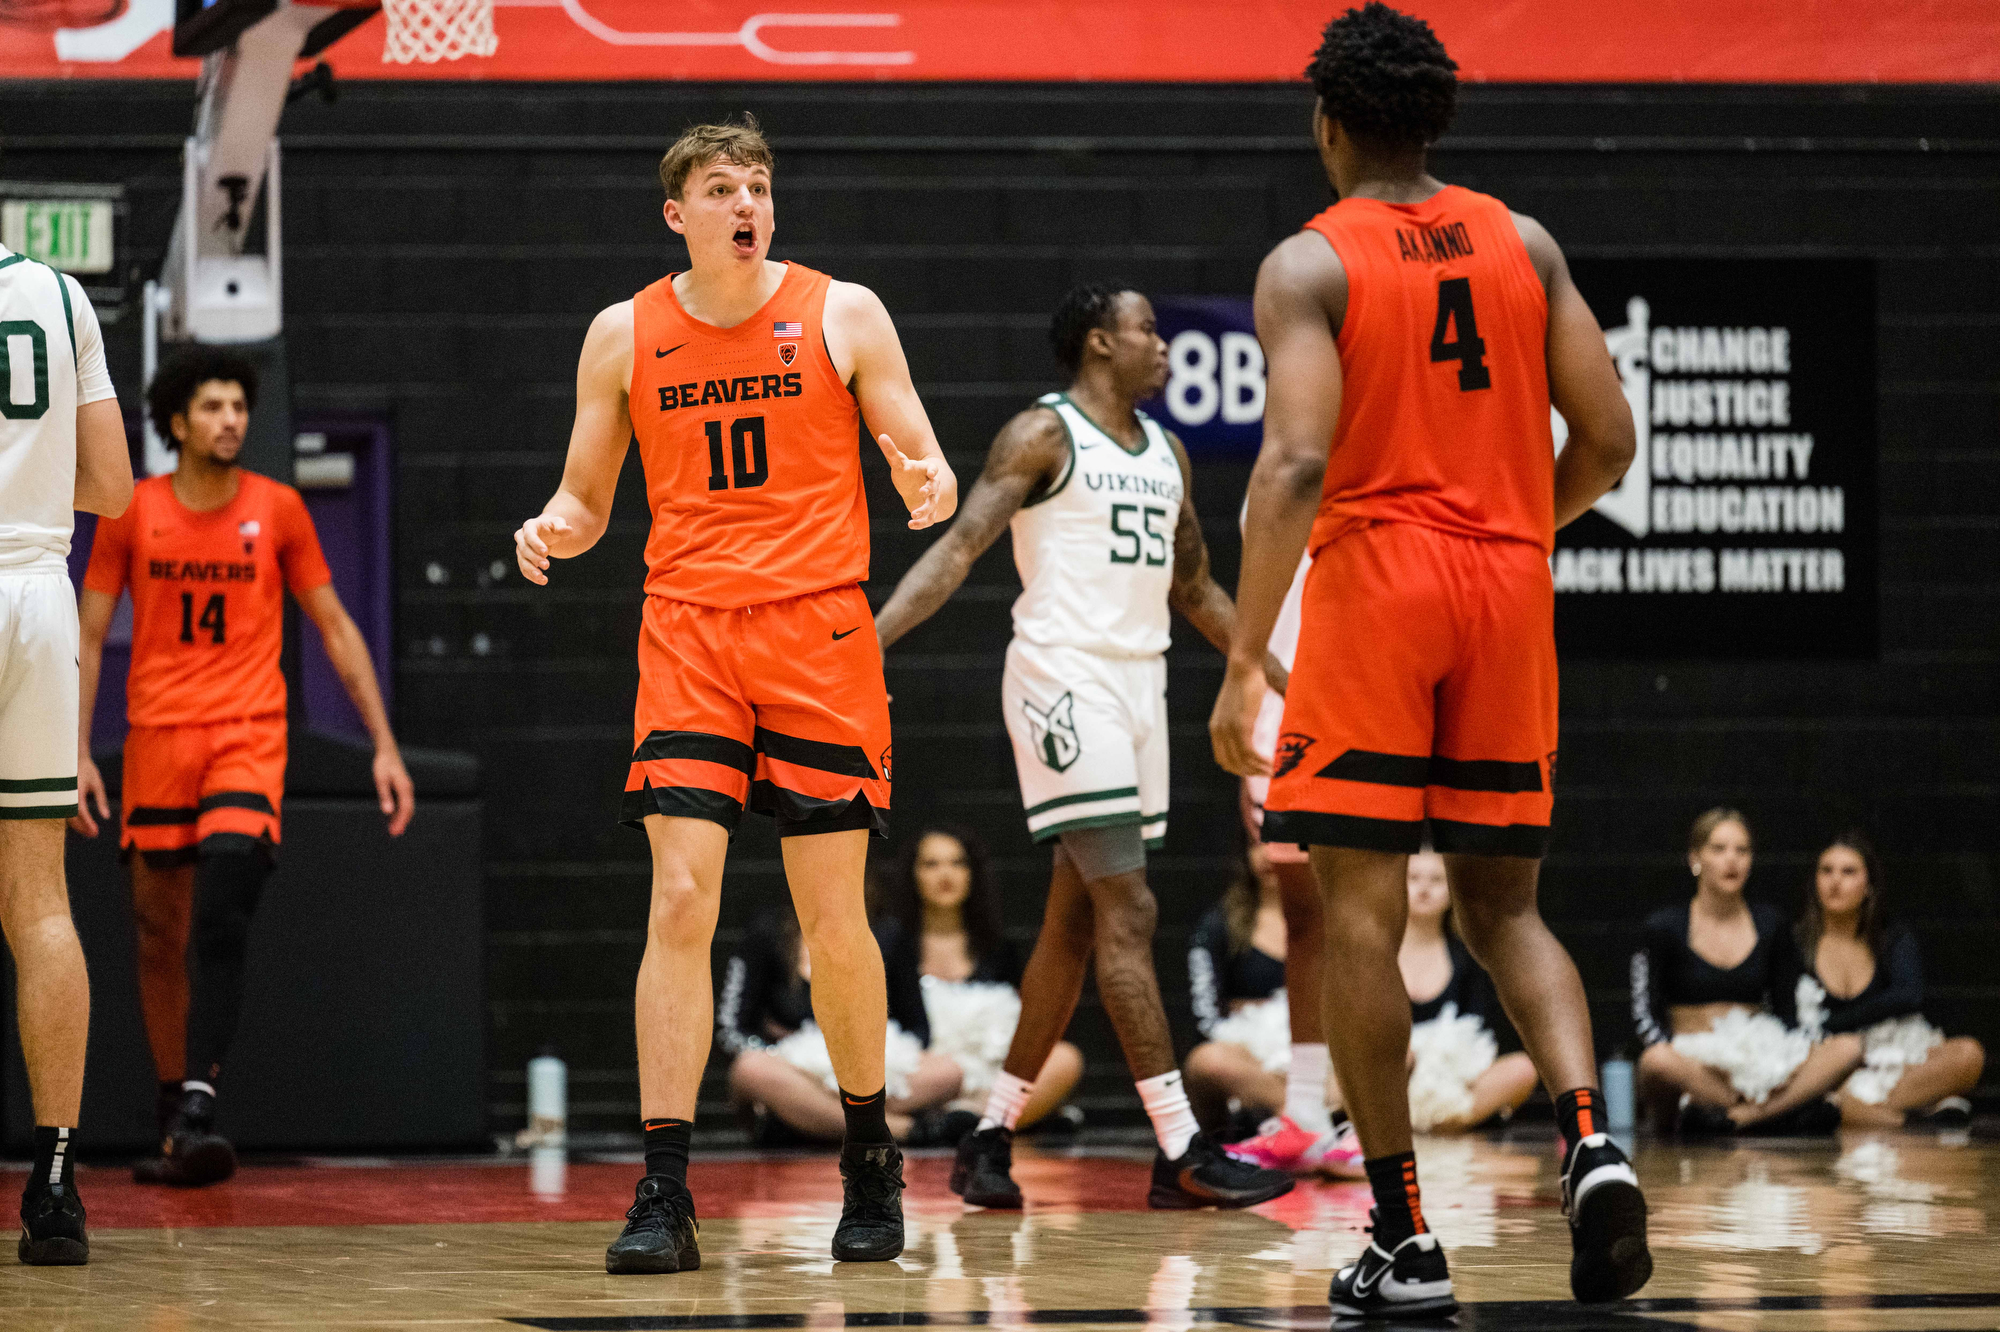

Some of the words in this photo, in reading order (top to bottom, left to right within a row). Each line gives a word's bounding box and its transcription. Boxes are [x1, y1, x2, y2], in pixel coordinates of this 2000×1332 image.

[25, 202, 91, 262] EXIT
[1395, 221, 1475, 263] AKANNO
[1430, 277, 1491, 392] 4
[1651, 326, 1791, 374] CHANGE
[658, 372, 802, 412] BEAVERS
[1165, 330, 1267, 425] 8B
[1650, 379, 1791, 427] JUSTICE
[704, 416, 769, 491] 10
[1651, 432, 1814, 484] EQUALITY
[1651, 485, 1845, 533] EDUCATION
[1110, 503, 1166, 566] 55
[149, 559, 256, 583] BEAVERS
[1547, 547, 1623, 593] ACK
[1626, 547, 1716, 593] LIVES
[1719, 547, 1846, 593] MATTER
[179, 592, 225, 644] 14
